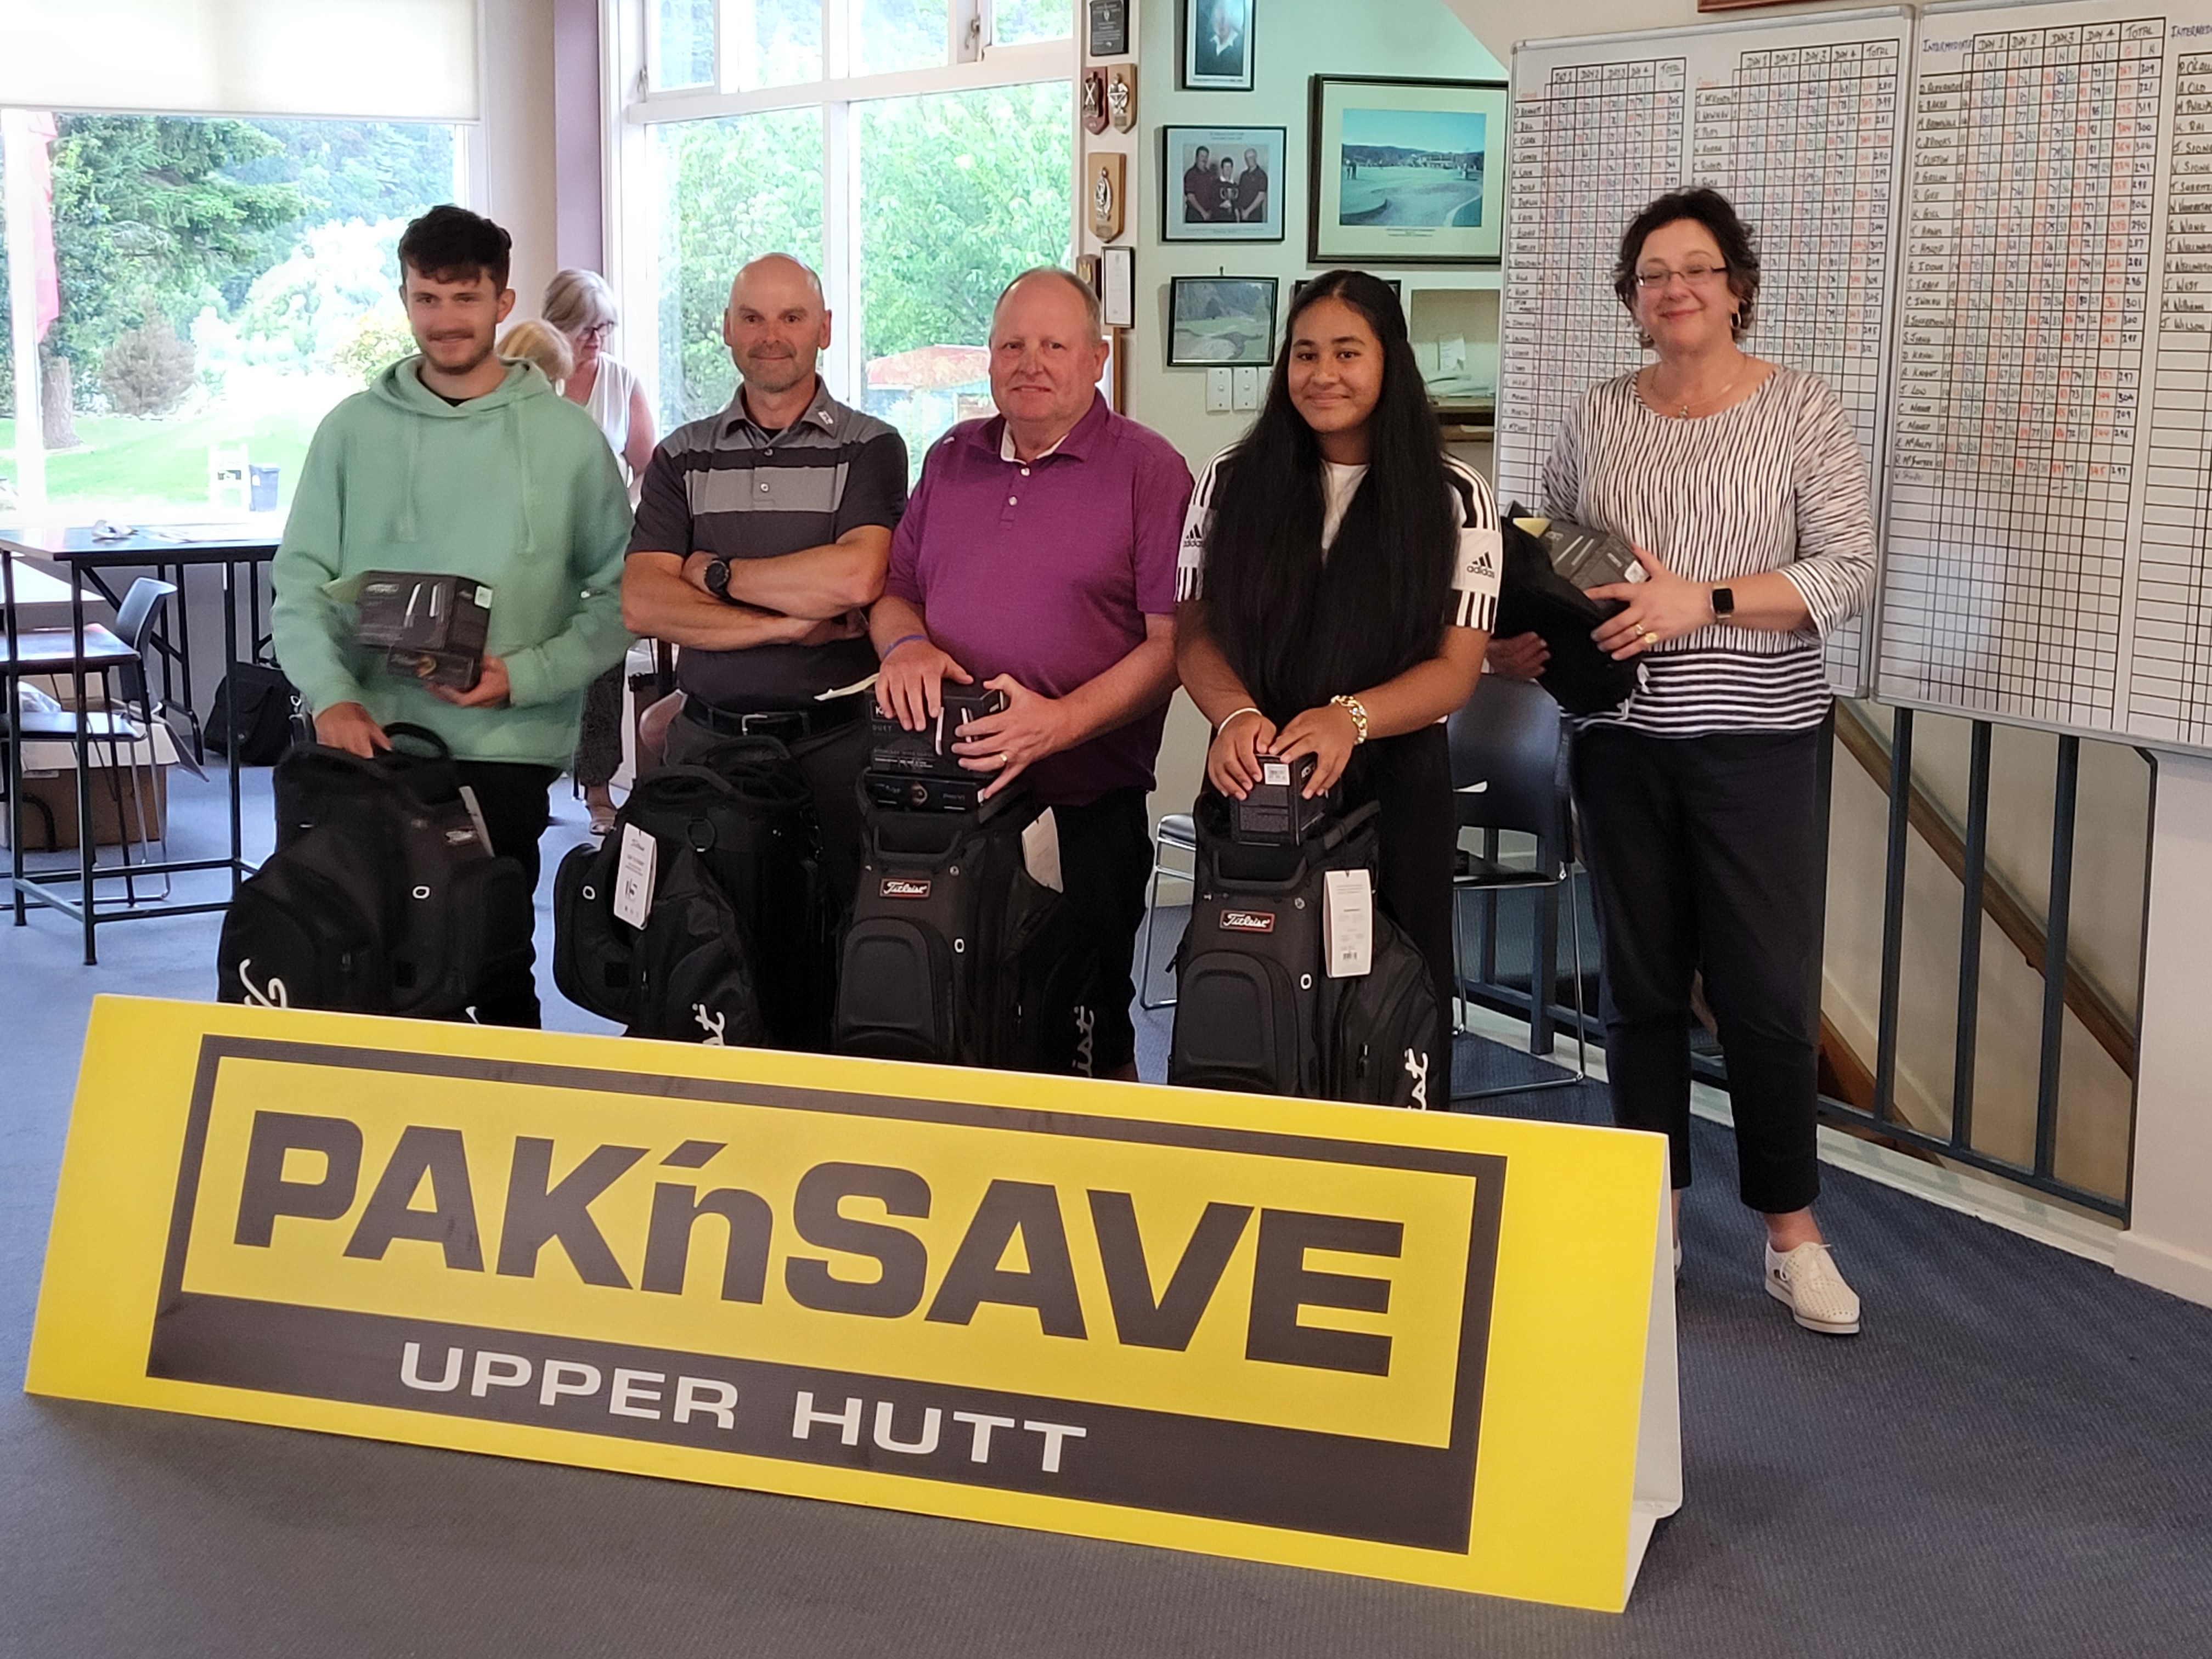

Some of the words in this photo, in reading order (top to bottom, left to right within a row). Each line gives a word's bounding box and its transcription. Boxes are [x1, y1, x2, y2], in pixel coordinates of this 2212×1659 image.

[2141, 64, 2154, 74] 309
[2137, 122, 2152, 132] 300
[2126, 298, 2141, 309] 301
[2124, 315, 2137, 325] 300
[2119, 371, 2133, 383] 297
[2117, 410, 2131, 419] 309
[2114, 429, 2129, 438] 296
[2112, 467, 2126, 477] 297
[1466, 565, 1495, 579] adidas
[399, 1341, 740, 1430] UPPER
[792, 1390, 1087, 1473] HUTT
